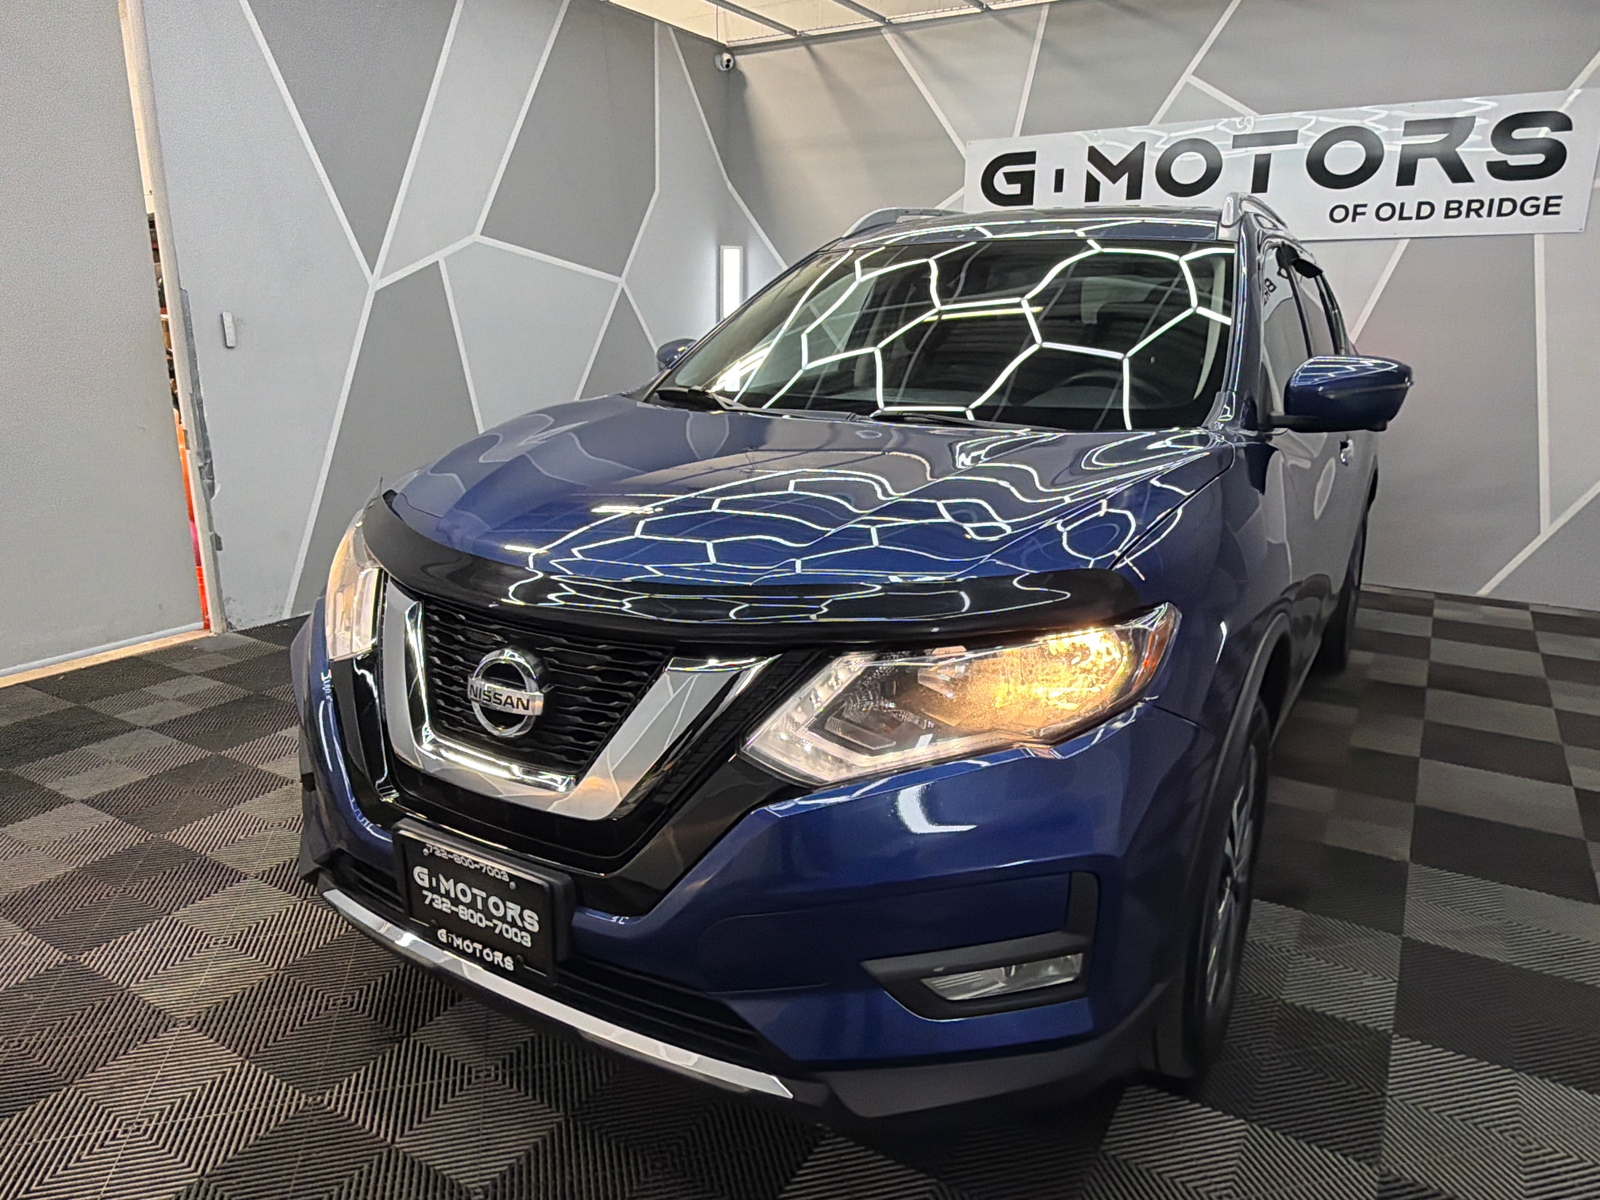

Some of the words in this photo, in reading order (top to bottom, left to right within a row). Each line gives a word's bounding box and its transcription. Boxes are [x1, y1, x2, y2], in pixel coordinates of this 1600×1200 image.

[1328, 204, 1368, 223] OF
[1375, 201, 1436, 222] OLD
[1444, 195, 1563, 219] BRIDGE
[469, 684, 530, 711] NISSAN
[422, 890, 532, 948] 732-800-7003
